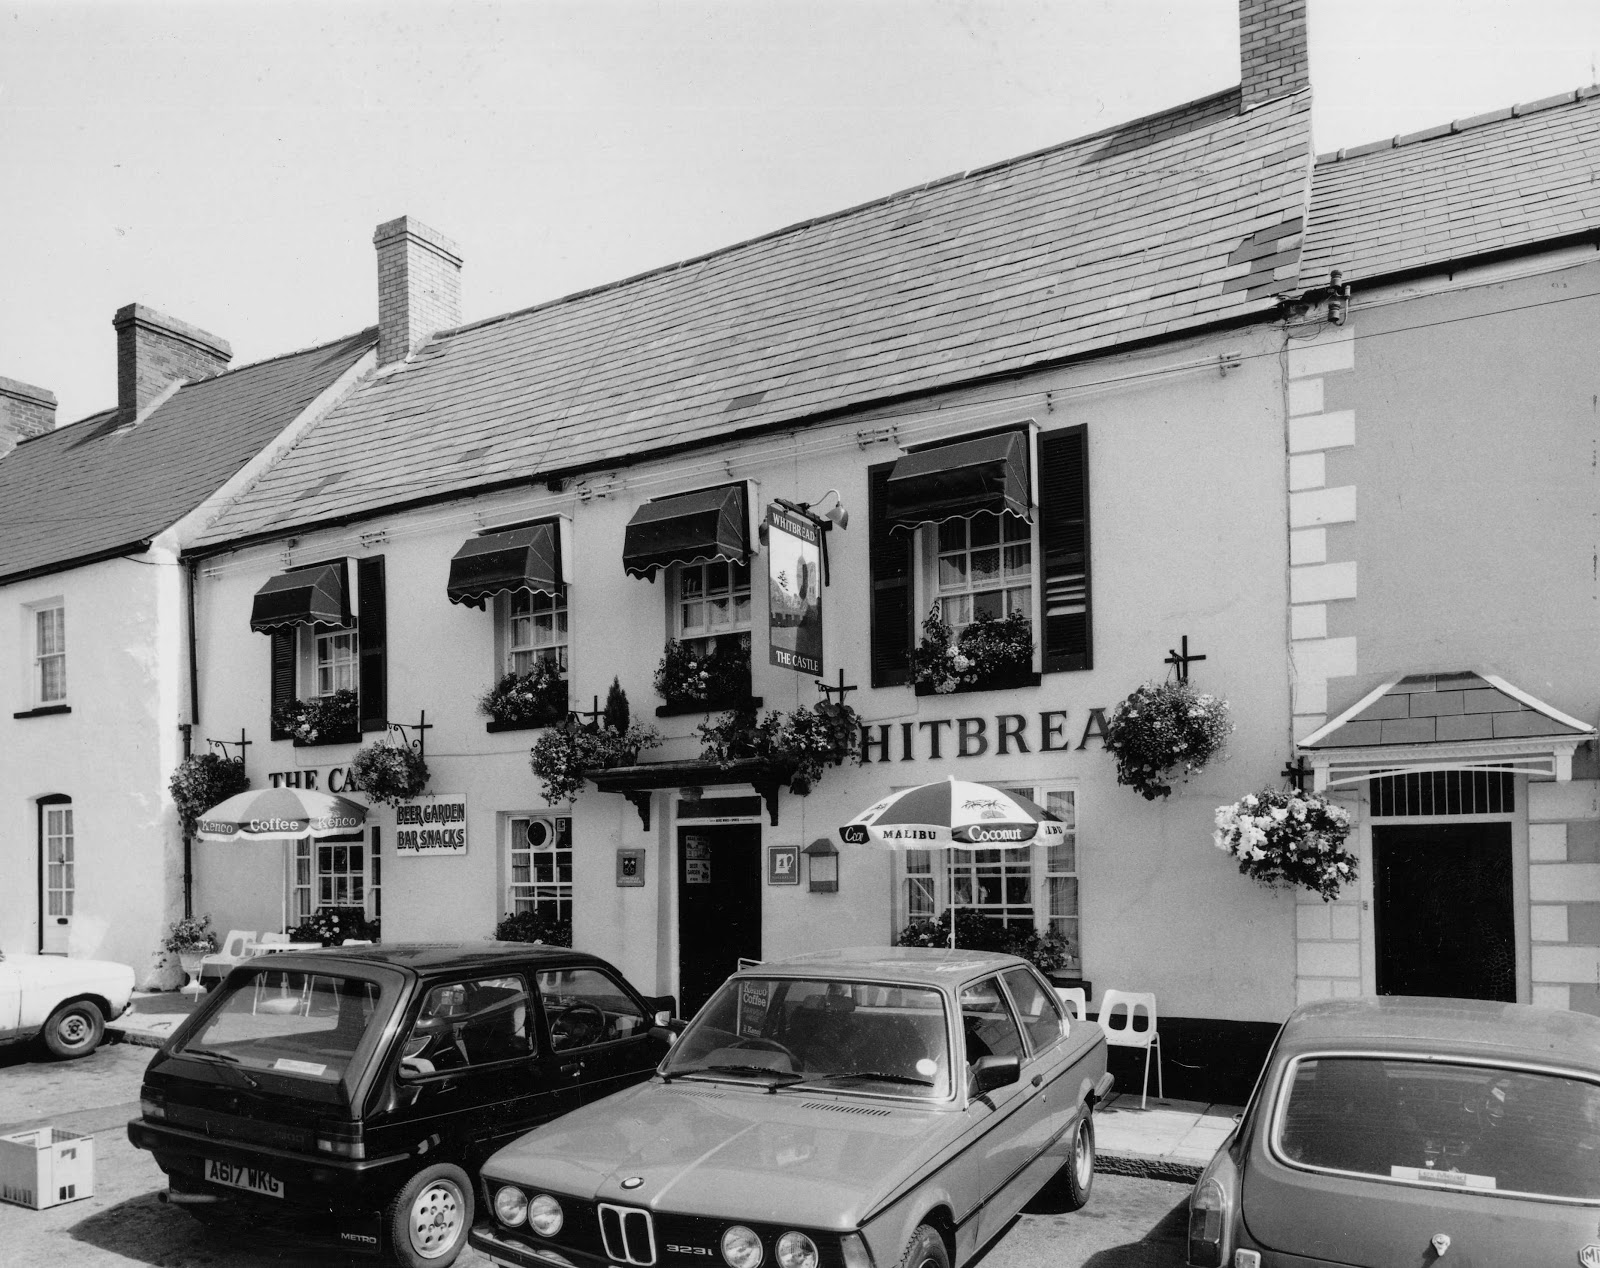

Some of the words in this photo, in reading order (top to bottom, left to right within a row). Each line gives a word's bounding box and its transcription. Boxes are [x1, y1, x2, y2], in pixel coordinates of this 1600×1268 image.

[772, 512, 815, 542] WHITBREAD
[776, 650, 791, 666] THE
[792, 655, 819, 672] CASTLE
[860, 707, 1113, 763] HITBREA
[268, 770, 318, 790] THE
[317, 816, 357, 830] Kenco
[397, 805, 424, 827] BEER
[423, 803, 465, 826] GARDEN
[201, 819, 233, 834] Kenco
[250, 818, 299, 831] Coffee
[1045, 826, 1063, 835] IBU
[396, 830, 419, 852] BAR
[419, 828, 465, 850] SNACKS
[882, 829, 937, 841] MALIBU
[968, 825, 1022, 842] Coconut
[743, 992, 767, 1007] Coffee
[209, 1160, 243, 1184] A617
[248, 1168, 279, 1193] WKG
[340, 1232, 377, 1244] METRO
[666, 1244, 713, 1256] 323i
